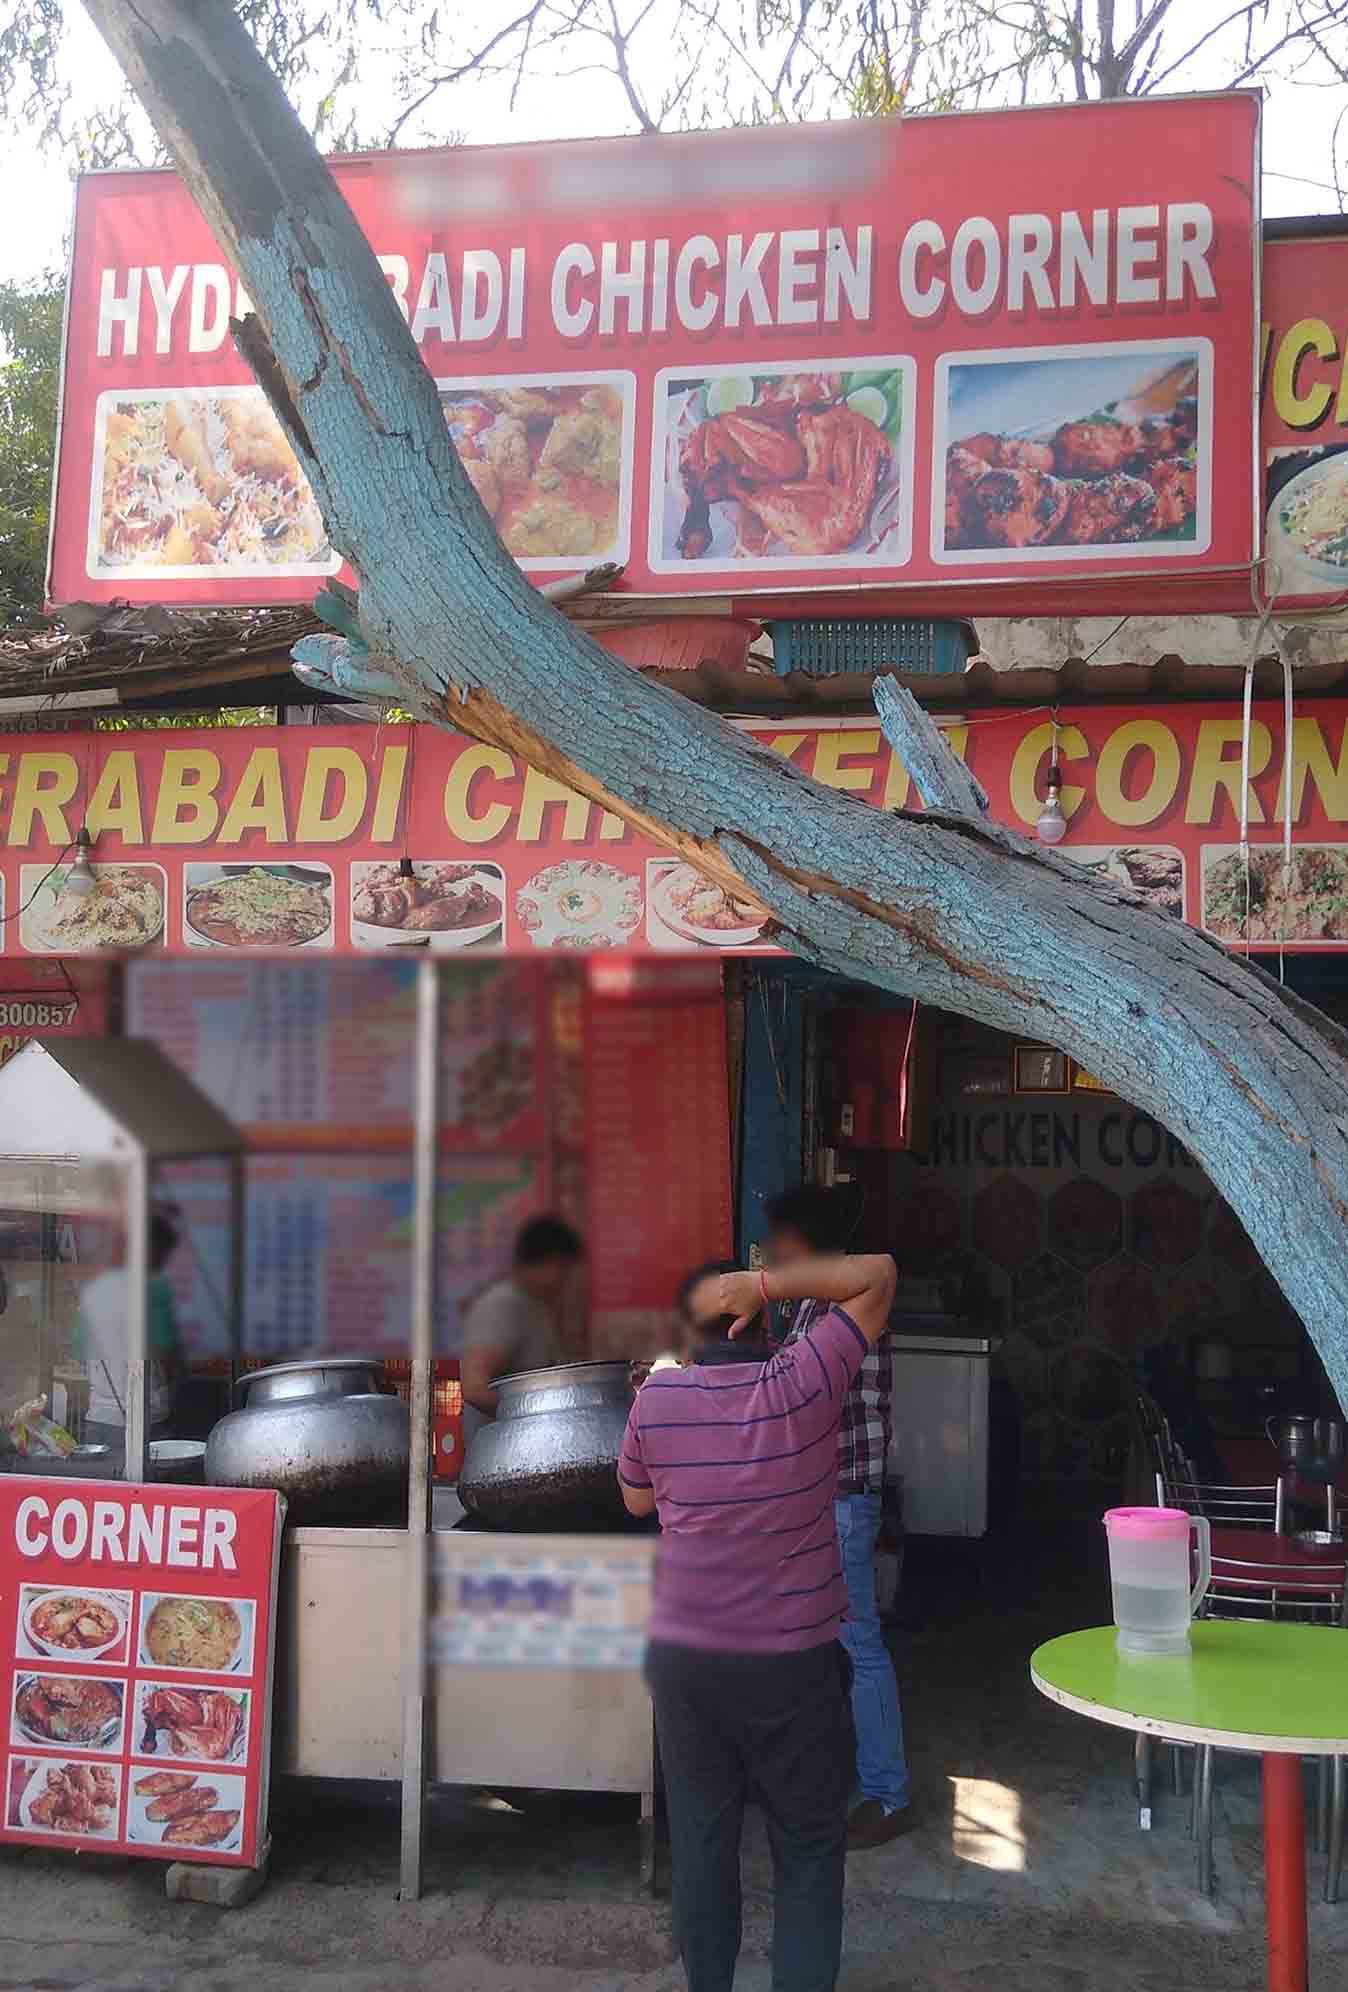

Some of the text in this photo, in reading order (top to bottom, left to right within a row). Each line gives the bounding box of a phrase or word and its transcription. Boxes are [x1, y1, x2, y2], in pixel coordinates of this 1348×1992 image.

[551, 225, 873, 339] CHICKEN
[900, 202, 1217, 318] CORNER
[15, 1496, 239, 1571] CORNER
